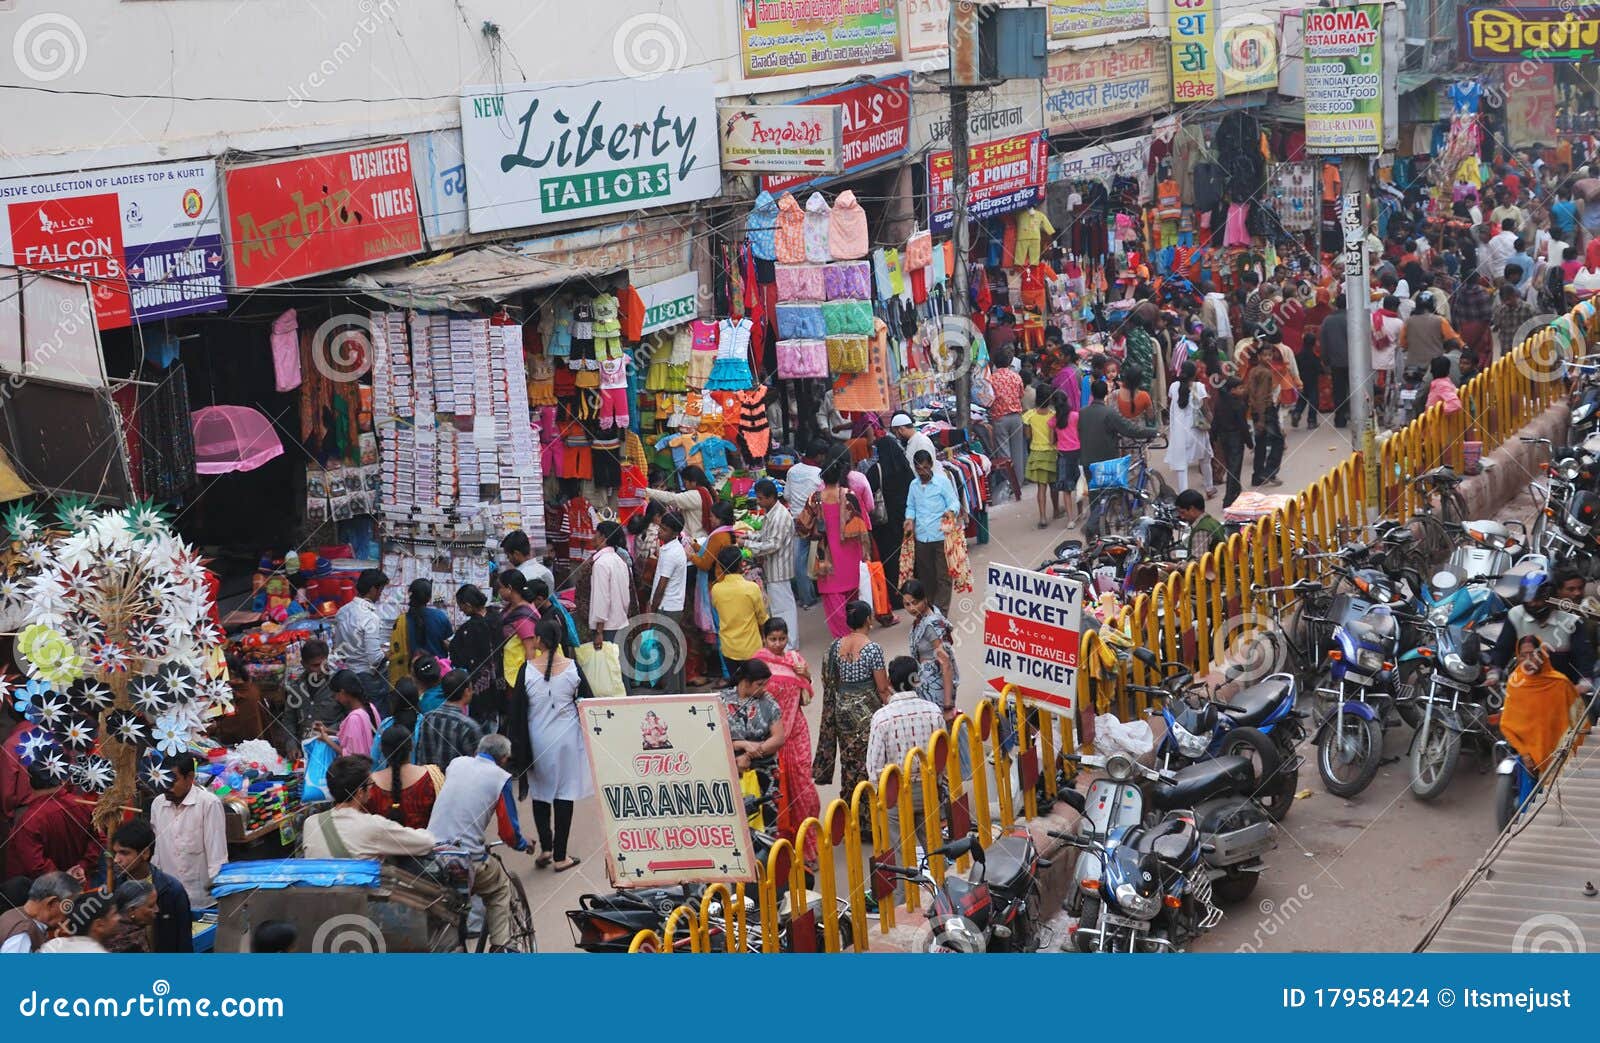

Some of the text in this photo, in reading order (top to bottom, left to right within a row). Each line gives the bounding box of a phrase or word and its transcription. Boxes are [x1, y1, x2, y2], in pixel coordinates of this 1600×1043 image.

[1306, 12, 1370, 31] AROMA
[1305, 32, 1376, 46] RESTAURANT
[1322, 64, 1344, 73] FOOD
[1322, 76, 1349, 86] INDIAN
[1351, 75, 1378, 84] FOOD
[1350, 88, 1377, 97] FOOD
[474, 96, 504, 119] NEW
[1329, 102, 1352, 111] FOOD
[500, 98, 697, 182] Liberty
[751, 121, 823, 145] Anokhi
[869, 127, 904, 154] HOSIERY
[349, 148, 408, 181] BEDSHEETS
[985, 159, 1028, 184] POWER
[31, 178, 93, 195] COLLECTION
[95, 178, 109, 187] OF
[111, 175, 145, 186] LADIES
[148, 172, 166, 183] TOP
[168, 171, 174, 180] &
[177, 168, 205, 179] KURTI
[543, 168, 668, 208] TAILORS
[370, 187, 414, 220] TOWELS
[25, 237, 113, 264] FALCON
[644, 297, 695, 325] AILORS
[988, 567, 1077, 604] RAILWAY
[995, 593, 1068, 626] TICKET
[984, 632, 1076, 664] FALCON TRAVELS
[985, 649, 1074, 686] AIR TICKET
[633, 753, 692, 776] THE
[604, 780, 736, 820] VARANASI
[618, 825, 735, 851] SILK HOUSE
